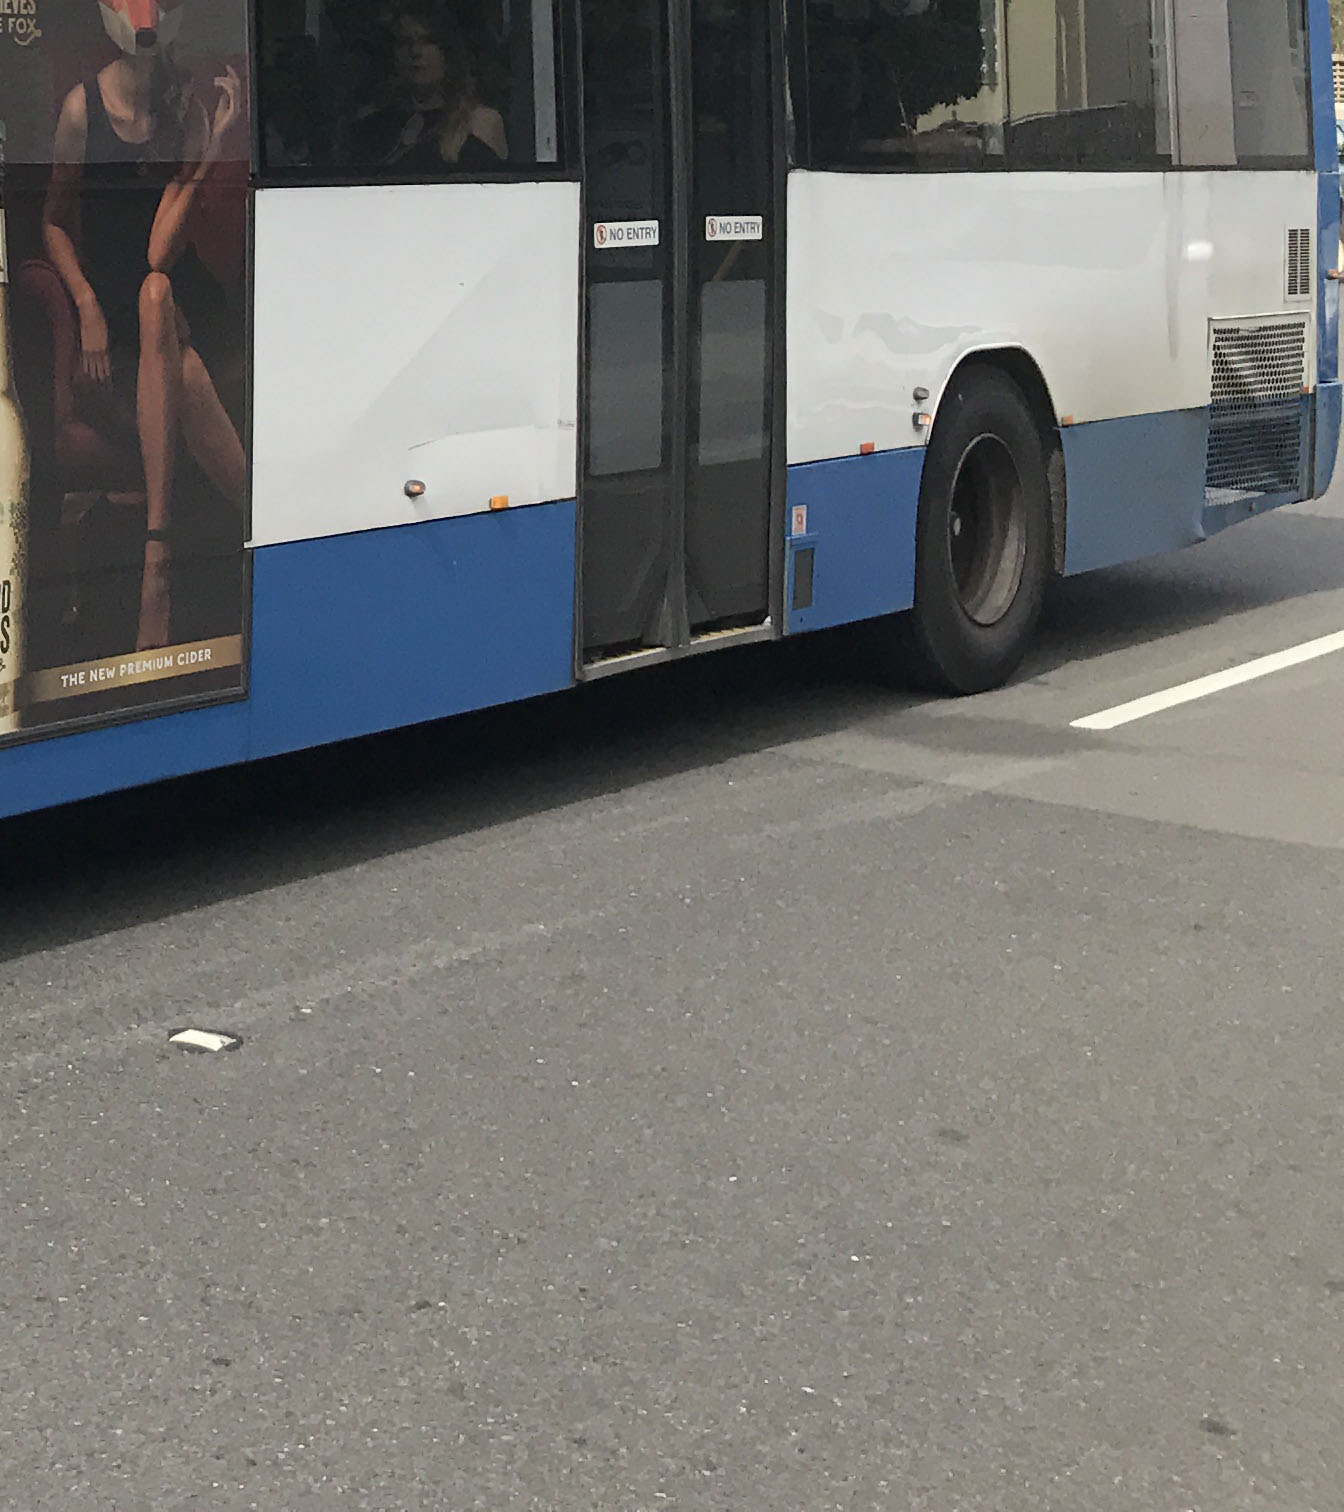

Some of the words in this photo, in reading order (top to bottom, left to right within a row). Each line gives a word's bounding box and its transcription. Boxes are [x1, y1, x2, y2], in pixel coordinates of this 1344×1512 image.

[8, 17, 42, 46] FOX
[609, 227, 624, 241] NO
[626, 226, 658, 241] ENTRY
[719, 221, 733, 235] NO
[734, 220, 761, 235] ENTRY
[61, 671, 86, 688] THE
[89, 666, 116, 683] NEW
[119, 655, 173, 677] PREMIUM
[177, 648, 212, 666] CIDER
